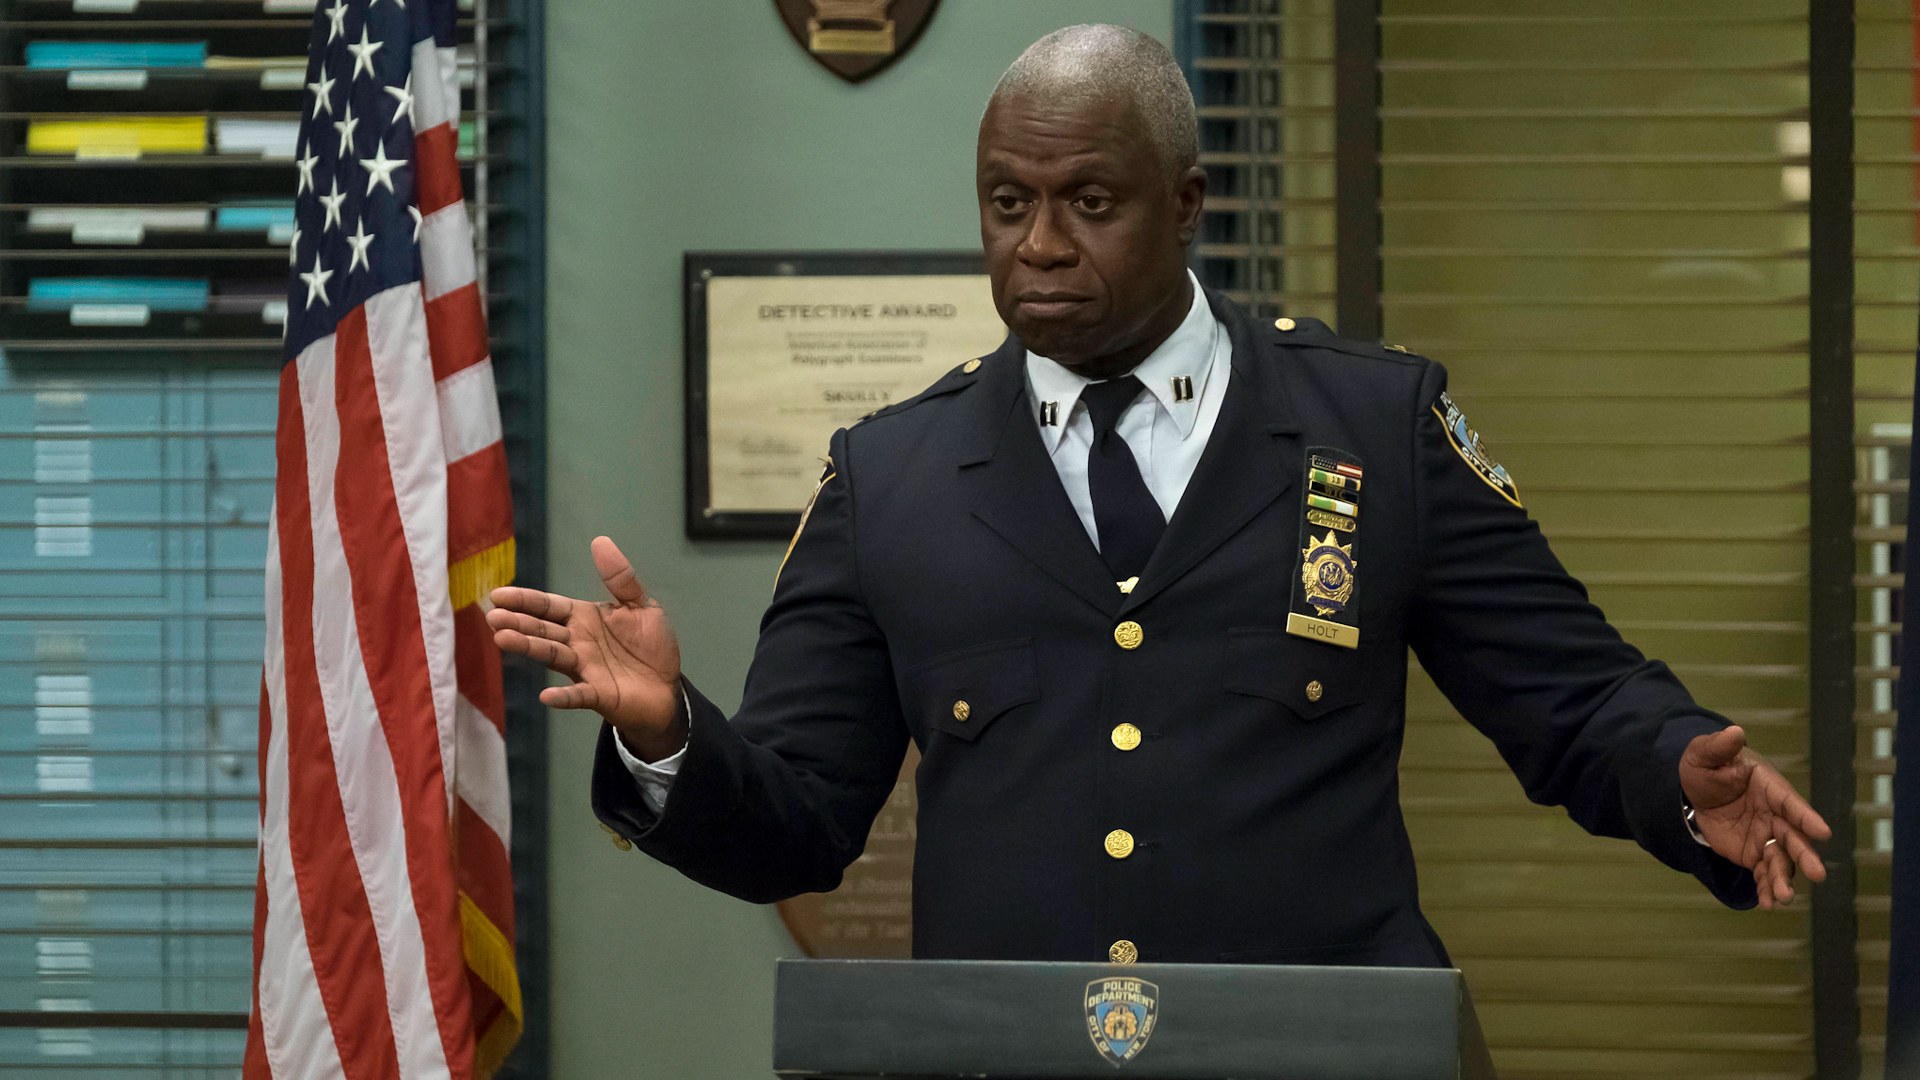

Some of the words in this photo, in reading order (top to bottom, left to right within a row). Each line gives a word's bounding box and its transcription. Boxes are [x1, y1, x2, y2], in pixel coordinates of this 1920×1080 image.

[758, 303, 873, 319] DETECTIVE
[878, 303, 958, 319] AWARD
[1461, 446, 1487, 473] CITY
[1324, 485, 1346, 499] WTC
[1307, 622, 1339, 639] HOLT
[1103, 981, 1141, 993] POLICE
[1088, 991, 1155, 1009] DEPARTMENT
[1089, 1015, 1101, 1039] CITY
[1098, 1041, 1110, 1053] OF
[1123, 1040, 1140, 1060] NEW
[1140, 1014, 1154, 1038] YORK
